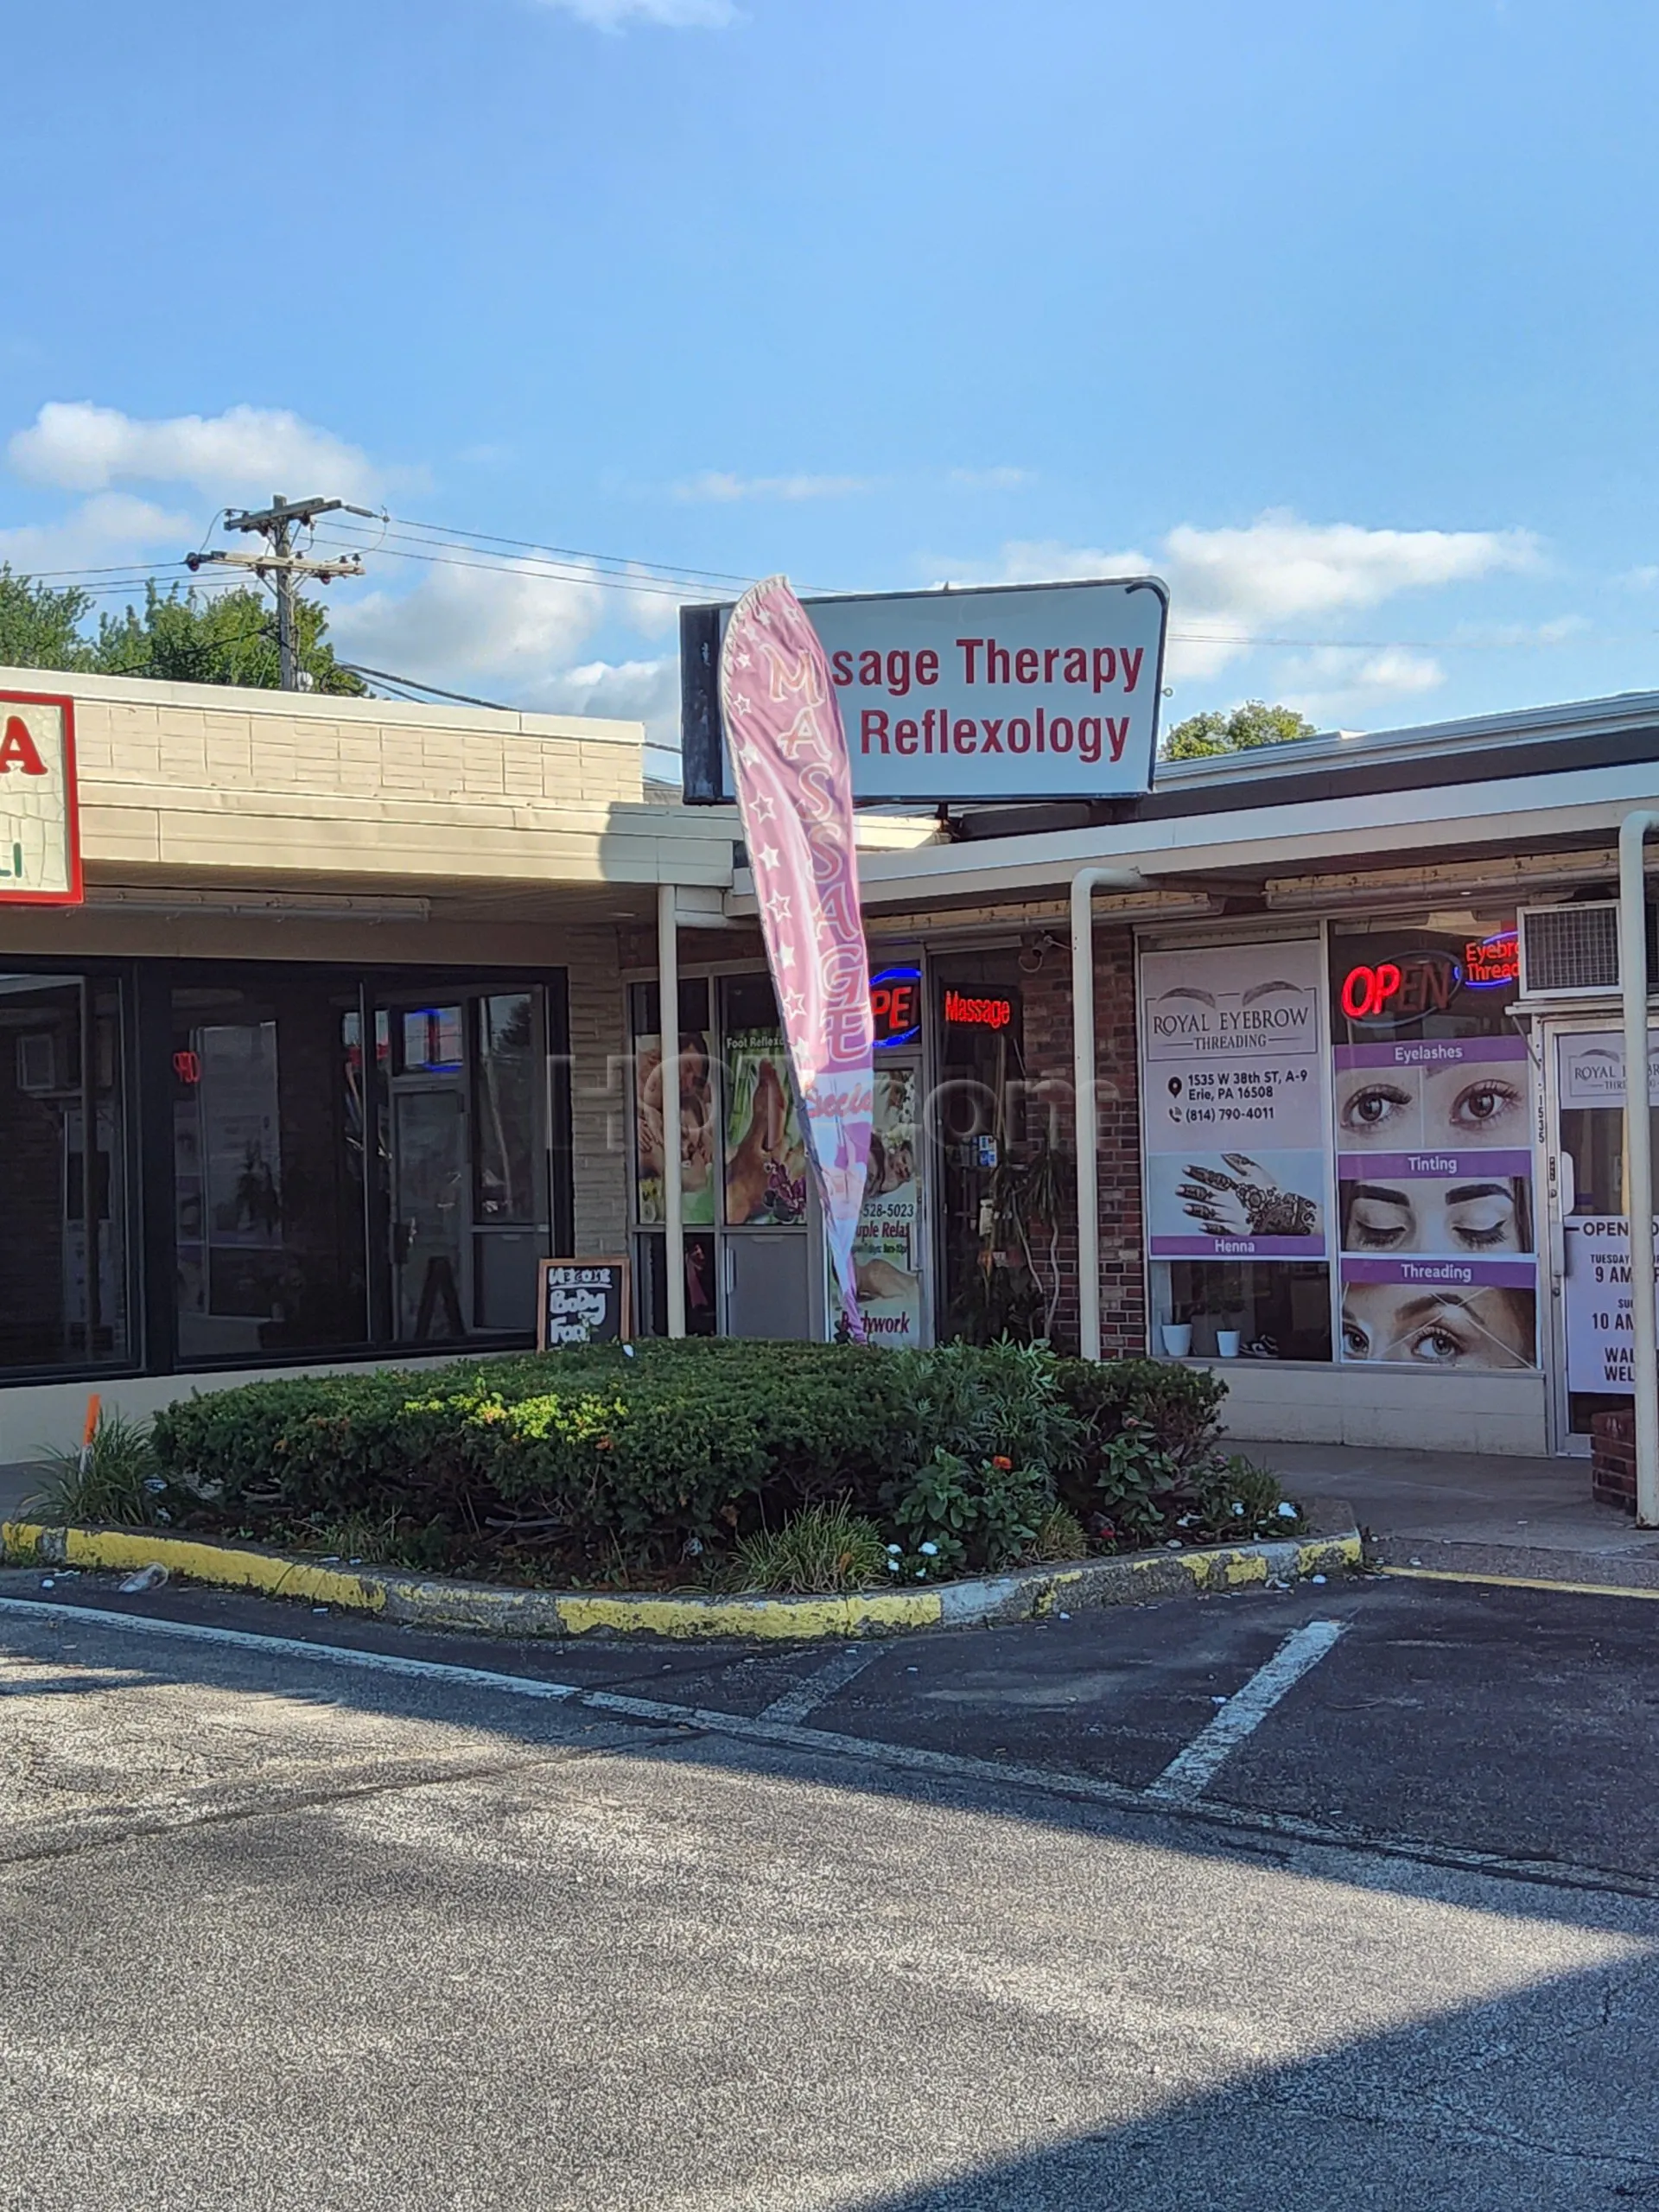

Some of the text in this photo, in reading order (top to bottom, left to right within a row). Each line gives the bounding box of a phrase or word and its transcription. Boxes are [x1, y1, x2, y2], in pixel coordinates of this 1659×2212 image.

[832, 639, 1144, 696] sage Therapy
[861, 708, 1131, 763] Reflexology
[760, 644, 873, 1062] MASSAGE
[1467, 961, 1519, 982] Thread
[1342, 963, 1450, 1017] OPEN
[946, 990, 1009, 1028] Massage
[1153, 1007, 1308, 1036] ROYAL EYEBROW
[727, 1037, 785, 1049] Foot Reflexo
[1193, 1033, 1267, 1050] THREADING
[1395, 1045, 1463, 1064] Eyelashes
[1187, 1070, 1308, 1086] 1535 W 38th ST, A-9
[1574, 1066, 1616, 1080] ROYAL
[1188, 1086, 1274, 1102] Erie, PA 16508
[1185, 1107, 1274, 1122] (814) 790-4011
[1408, 1156, 1457, 1173] Tinting
[1583, 1222, 1629, 1236] OPEN
[1215, 1239, 1255, 1253] Henna
[1591, 1254, 1630, 1264] TUESDAY
[1401, 1263, 1471, 1282] Threading
[1595, 1266, 1632, 1283] 9 AM
[842, 1311, 910, 1336] Bdywork
[1592, 1313, 1609, 1330] 10
